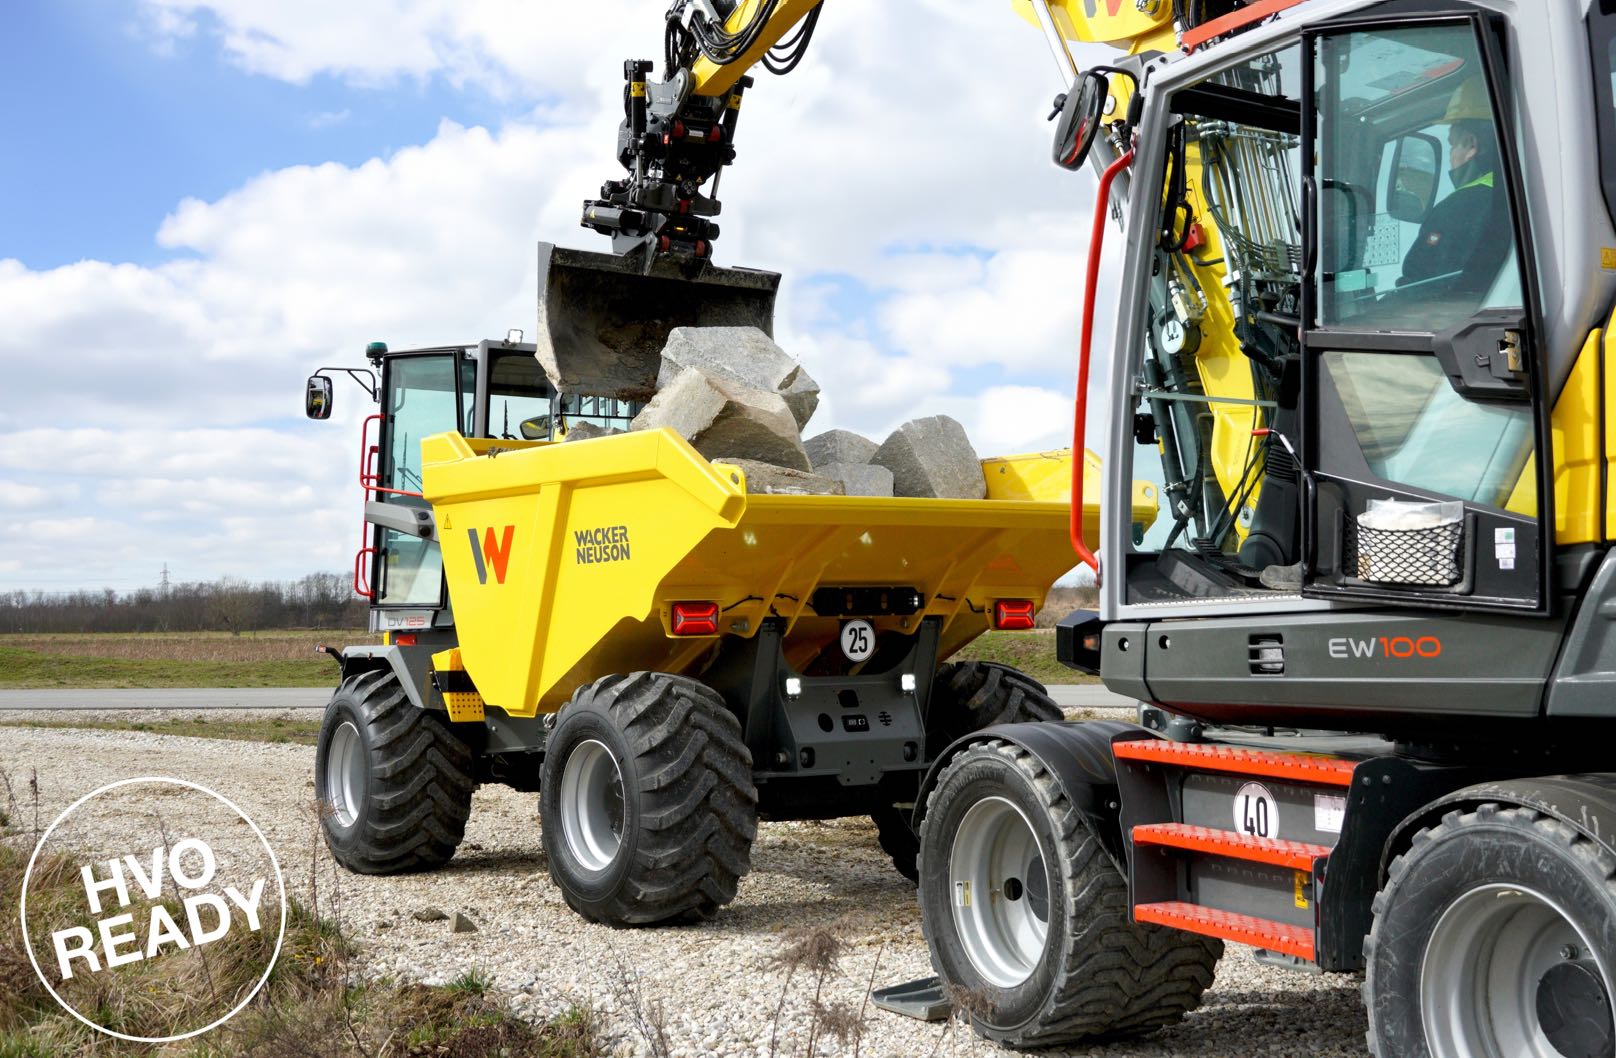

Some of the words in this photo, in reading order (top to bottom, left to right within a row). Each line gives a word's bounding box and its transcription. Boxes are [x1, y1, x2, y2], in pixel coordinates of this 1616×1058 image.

[574, 525, 629, 547] WACKER
[468, 525, 515, 584] W
[576, 543, 631, 565] NEUSON
[387, 616, 426, 627] DV125
[848, 626, 868, 654] 25
[1328, 636, 1441, 658] EW100
[1243, 794, 1268, 837] 40
